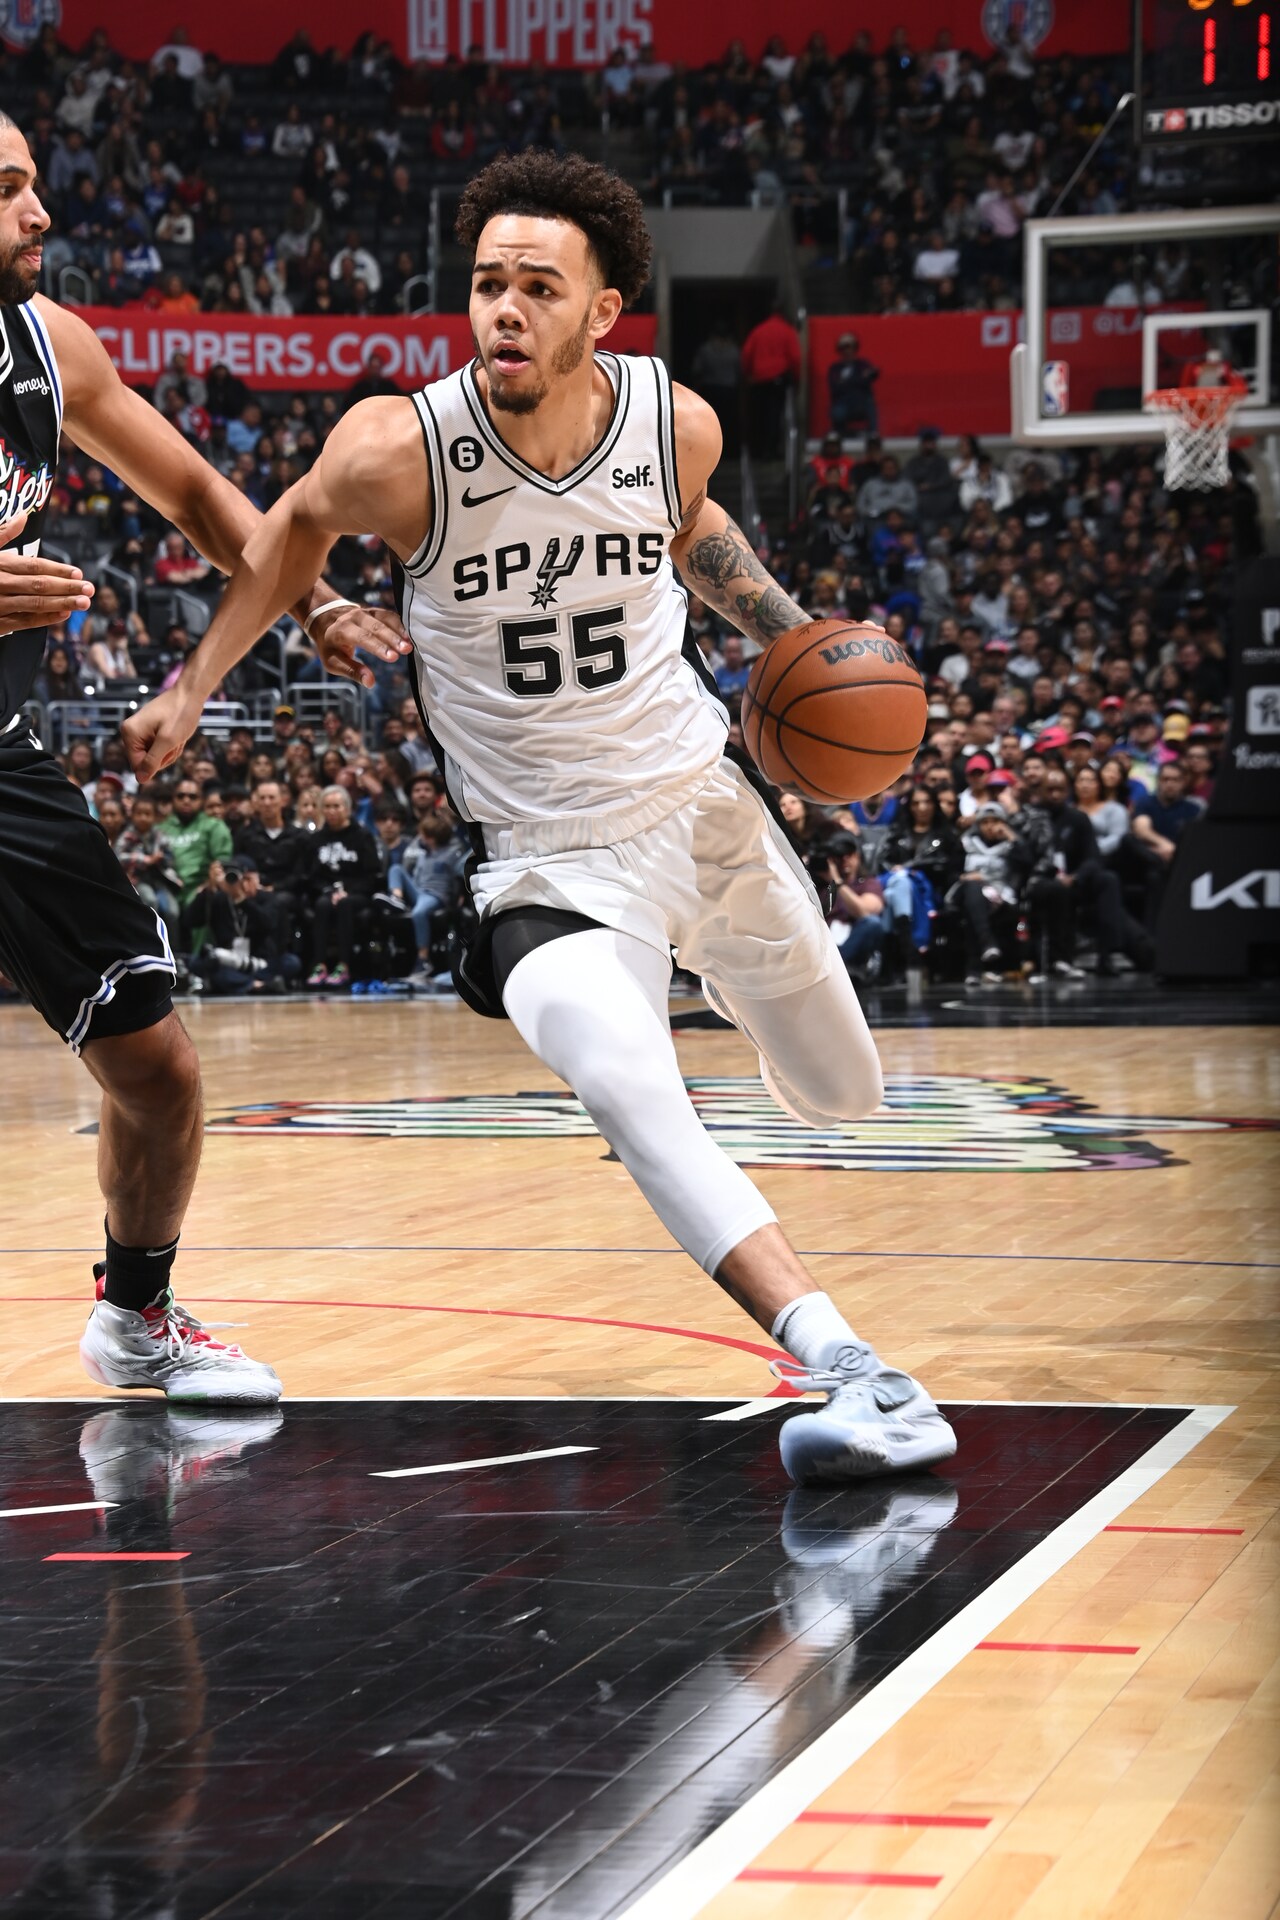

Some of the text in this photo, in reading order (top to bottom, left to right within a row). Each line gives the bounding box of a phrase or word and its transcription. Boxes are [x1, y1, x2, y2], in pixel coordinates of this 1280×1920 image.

[459, 0, 654, 63] CLIPPERS
[457, 442, 476, 468] 6
[612, 465, 654, 489] Self.
[453, 533, 664, 609] SPURS
[498, 602, 629, 698] 55
